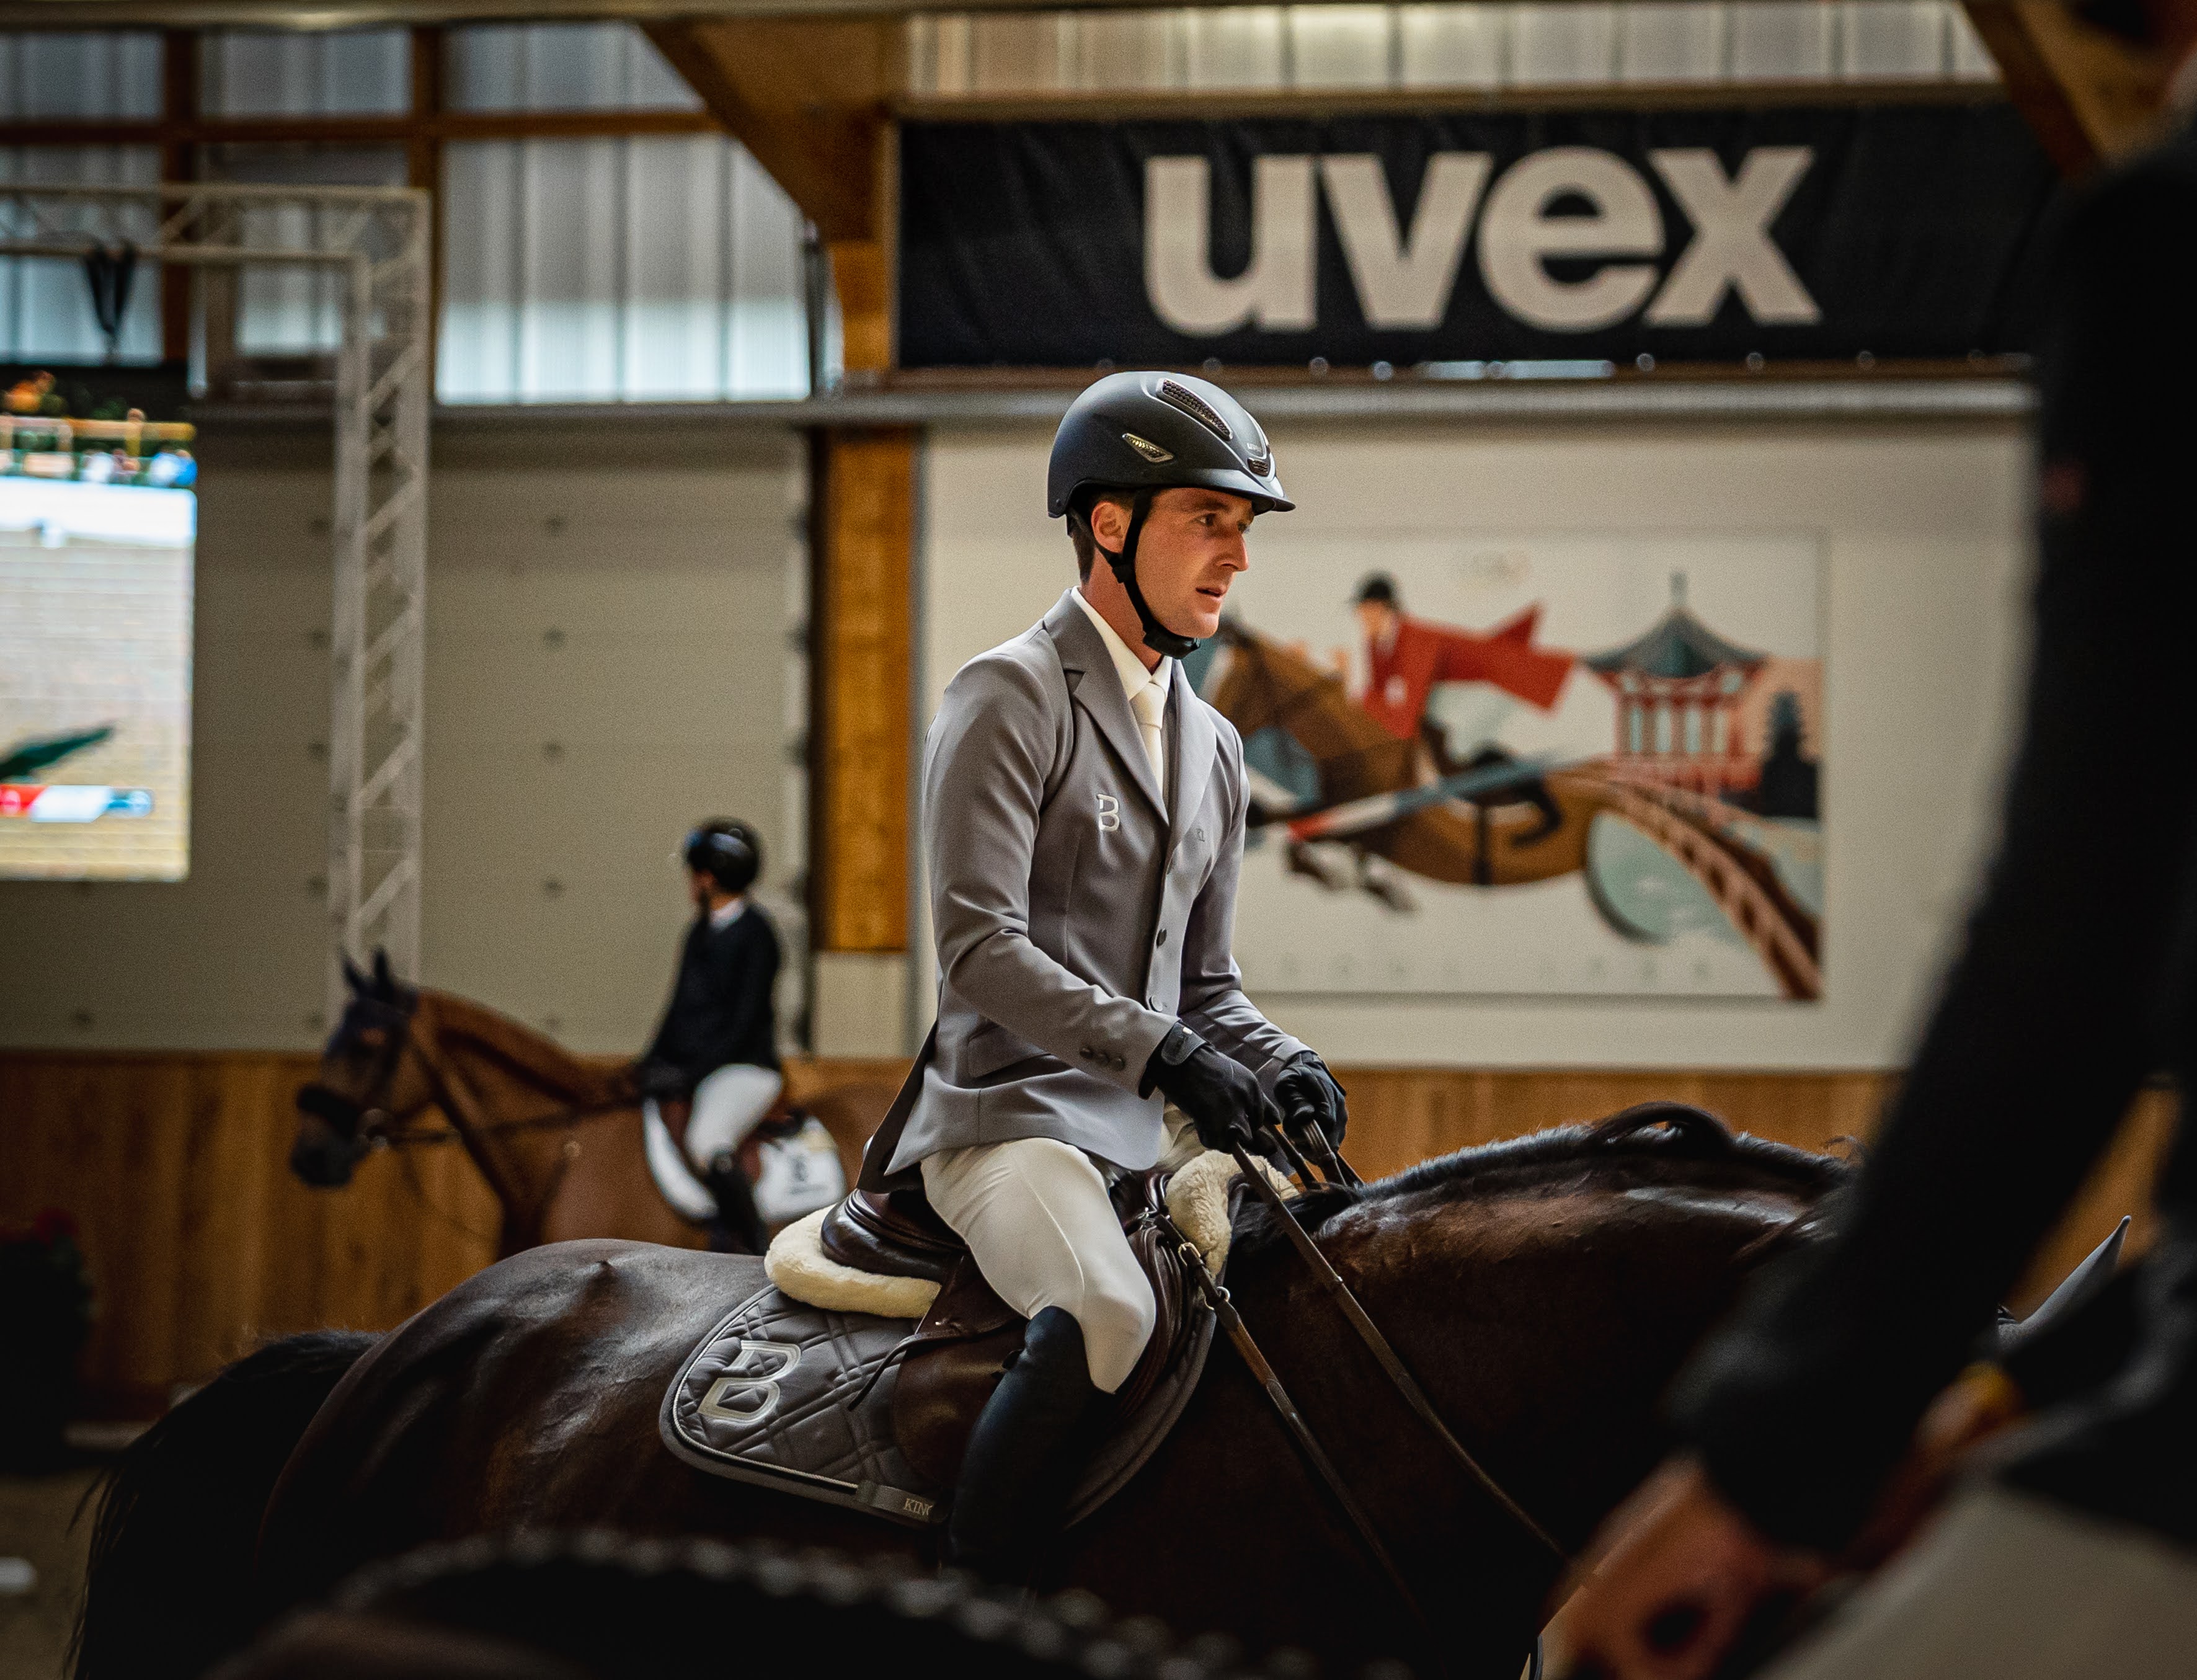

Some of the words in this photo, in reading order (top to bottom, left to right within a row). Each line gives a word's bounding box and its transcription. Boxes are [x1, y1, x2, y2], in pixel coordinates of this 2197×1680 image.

[1142, 145, 1822, 338] uvex
[1096, 793, 1120, 832] B
[697, 1340, 802, 1424] B
